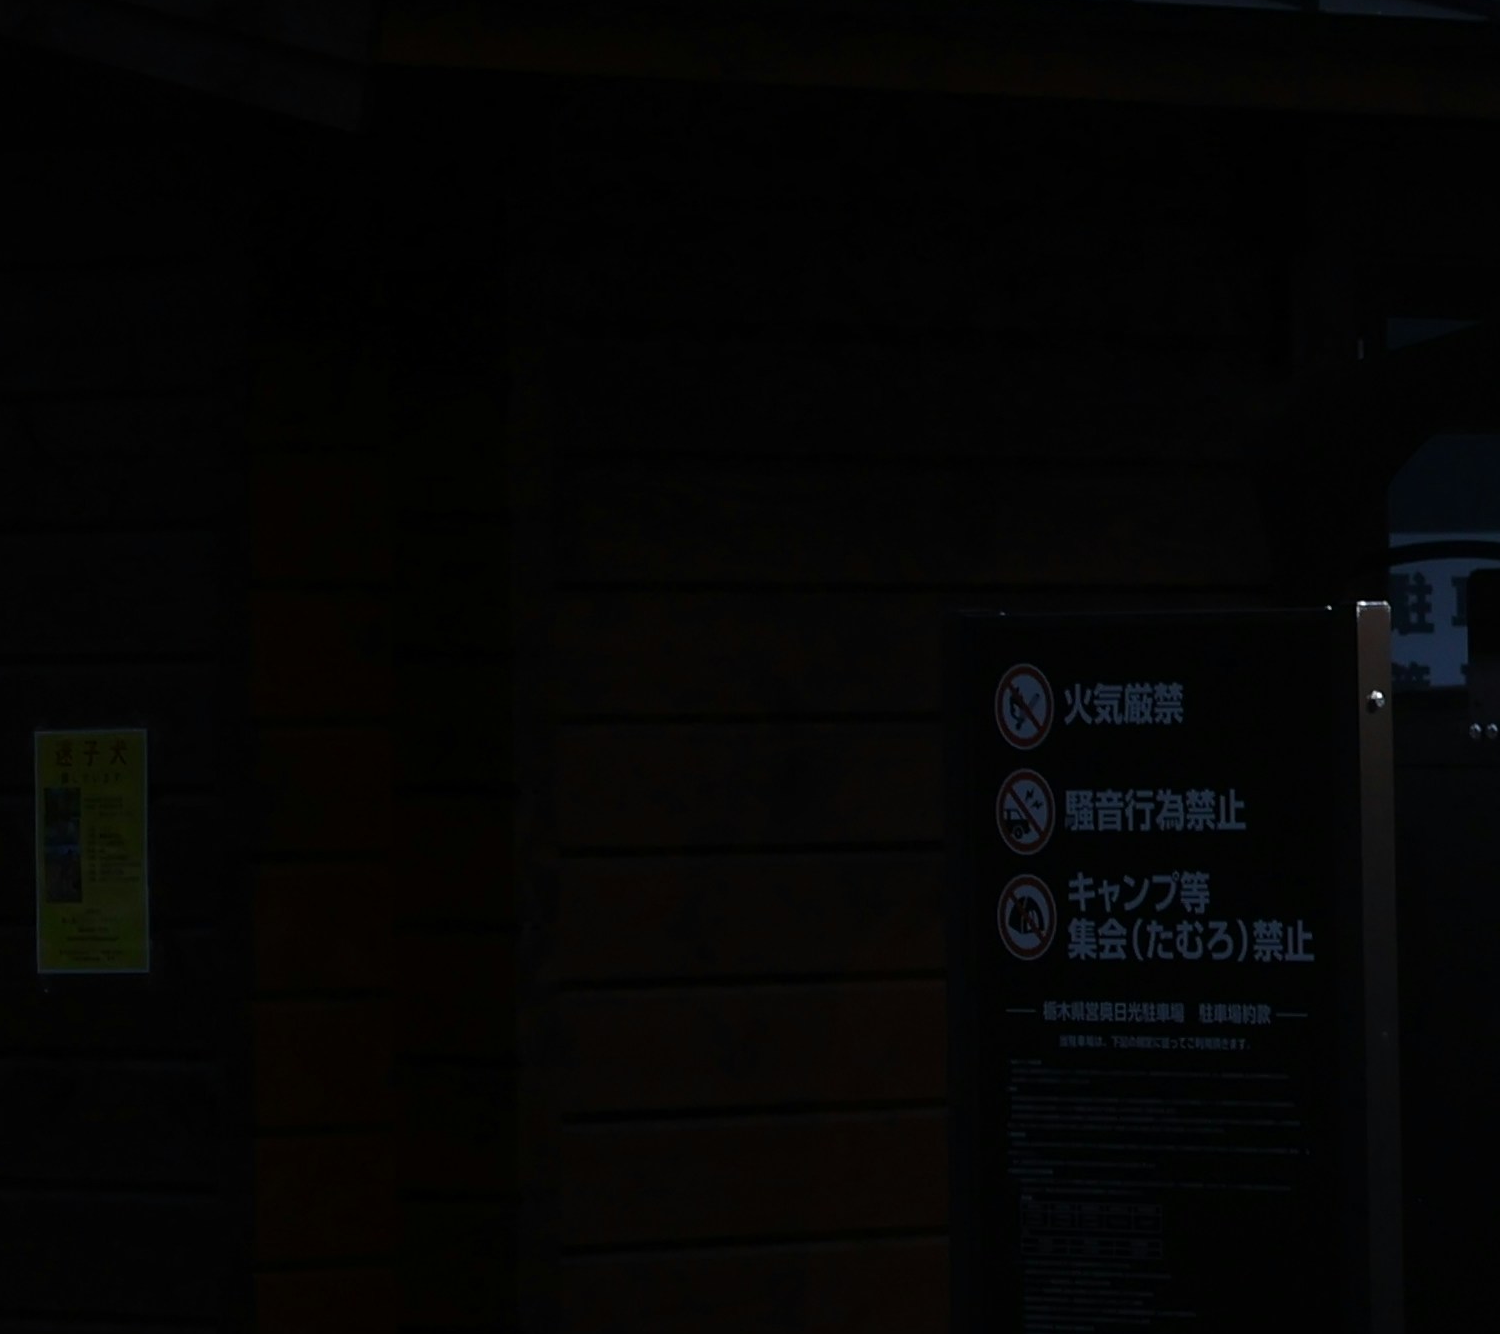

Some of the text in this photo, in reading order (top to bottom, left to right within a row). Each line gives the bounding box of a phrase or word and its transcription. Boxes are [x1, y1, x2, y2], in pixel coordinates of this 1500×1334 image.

[1063, 682, 1184, 726] 火気厳禁
[1064, 788, 1247, 832] 騒音行為禁止
[1067, 871, 1212, 915] キャンプ等
